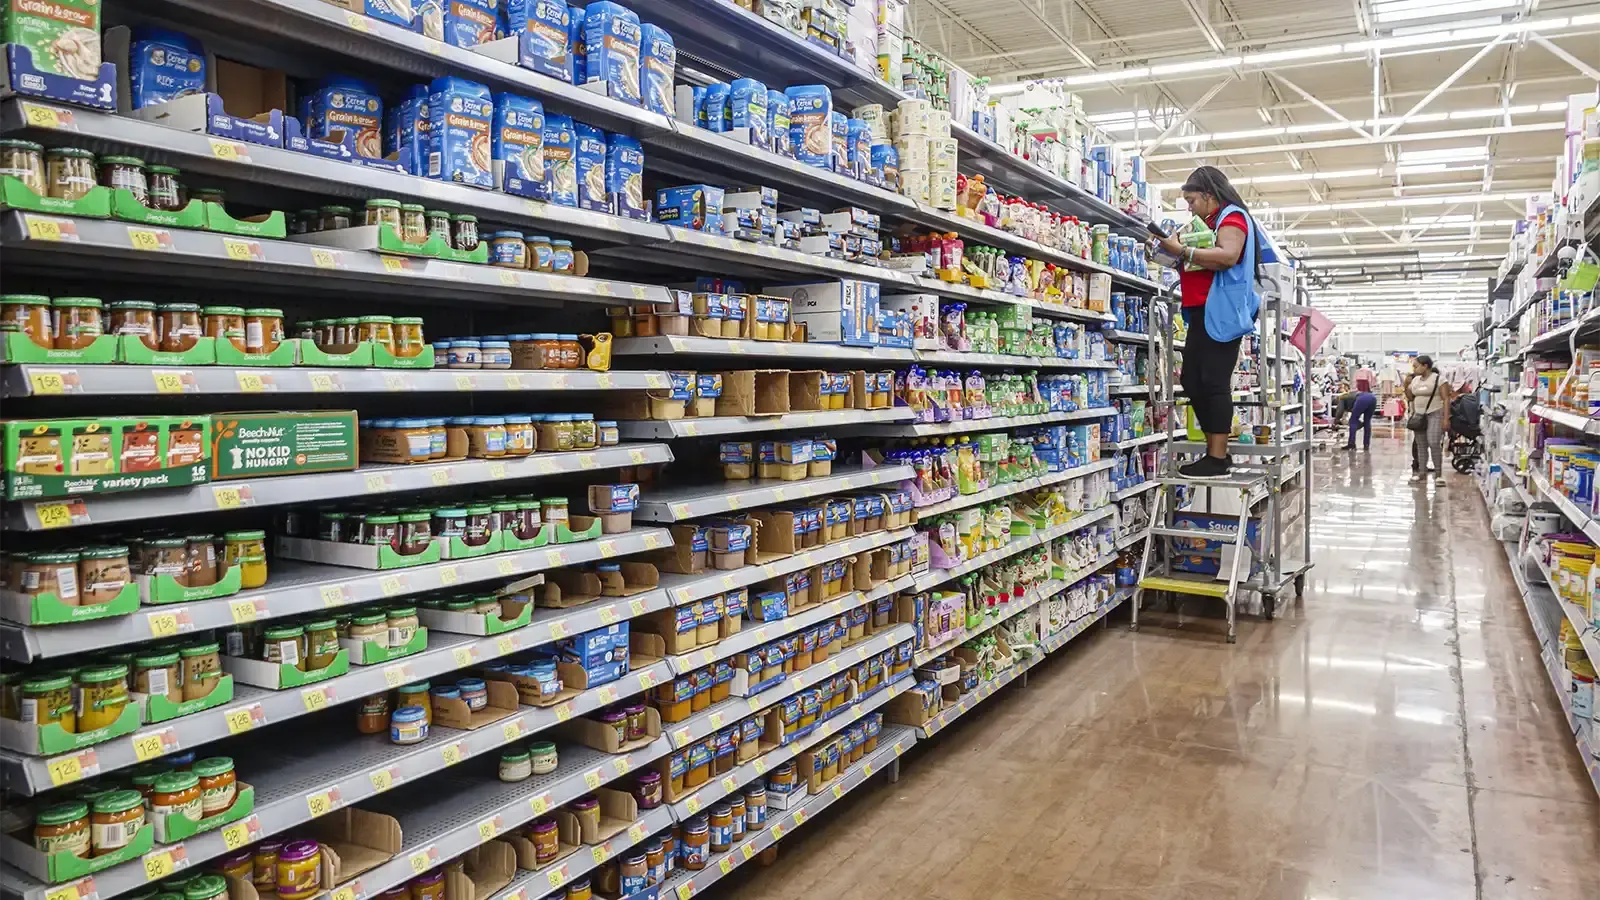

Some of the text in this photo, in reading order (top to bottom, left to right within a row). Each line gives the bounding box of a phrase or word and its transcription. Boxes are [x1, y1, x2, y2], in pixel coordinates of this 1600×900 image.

[156, 74, 175, 87] RICE
[329, 110, 353, 123] Grain
[449, 114, 469, 127] Grain
[504, 130, 523, 142] Grain
[239, 427, 285, 439] Beech-Nut
[246, 446, 291, 459] NO KID
[246, 456, 289, 468] HUNGRY
[192, 465, 206, 476] 16
[64, 478, 100, 489] Beech-Nut
[102, 474, 169, 489] variety pack
